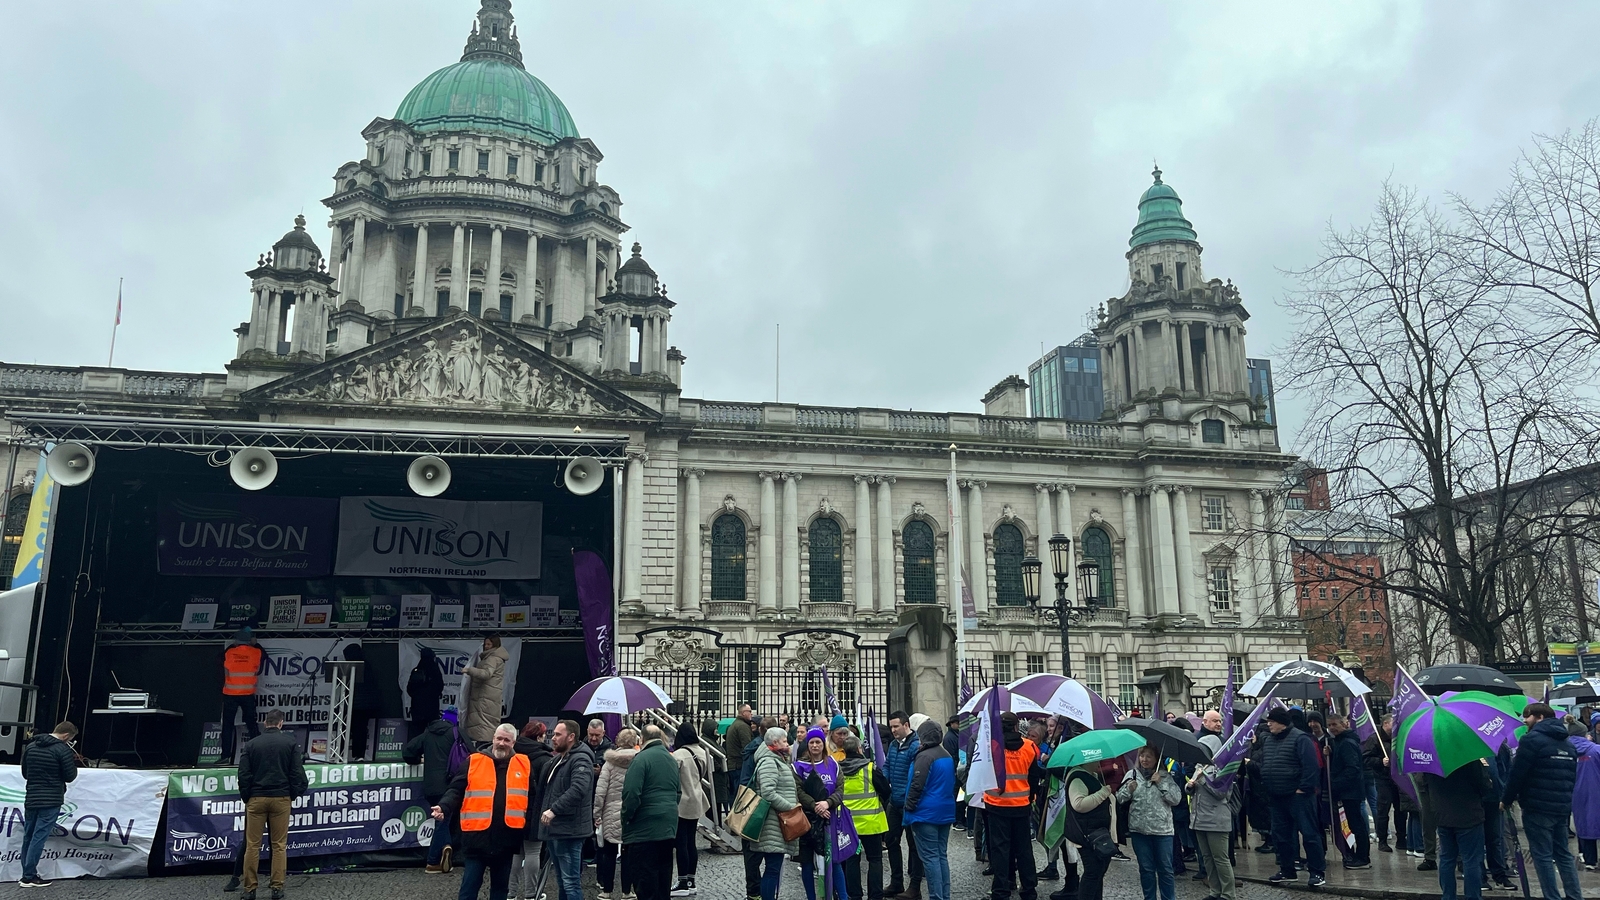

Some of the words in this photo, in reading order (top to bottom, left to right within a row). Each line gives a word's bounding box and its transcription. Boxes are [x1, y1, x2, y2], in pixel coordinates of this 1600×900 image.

[178, 521, 308, 550] UNISON
[372, 526, 510, 558] UNISON
[174, 556, 202, 567] South
[205, 556, 216, 567] &
[218, 558, 238, 568] East
[240, 558, 272, 570] Belfast
[274, 558, 308, 569] Branch
[389, 566, 442, 575] NORTHERN
[444, 568, 487, 577] IRELAND
[436, 657, 468, 675] NIS
[278, 694, 331, 706] Workers
[296, 710, 330, 721] Bette
[1059, 702, 1083, 716] UNISON
[1483, 716, 1503, 736] UNISON
[1410, 752, 1432, 760] UNISON
[304, 770, 316, 785] e
[321, 765, 358, 784] left
[362, 763, 423, 781] behin
[181, 774, 218, 794] We
[202, 800, 245, 815] Fund
[291, 795, 310, 808] or
[314, 790, 348, 807] NHS
[352, 787, 392, 802] staff
[395, 787, 411, 800] in
[0, 806, 134, 845] NSON
[234, 814, 312, 831] Nern
[316, 806, 380, 825] Ireland
[405, 812, 423, 828] UP
[385, 823, 402, 837] PAY
[421, 825, 434, 838] NO
[174, 836, 228, 852] UNISON
[321, 838, 344, 847] Abbey
[346, 835, 373, 845] Branch
[0, 850, 21, 861] elfa
[40, 849, 61, 860] City
[64, 849, 114, 861] Hospital
[205, 852, 232, 860] Ireland
